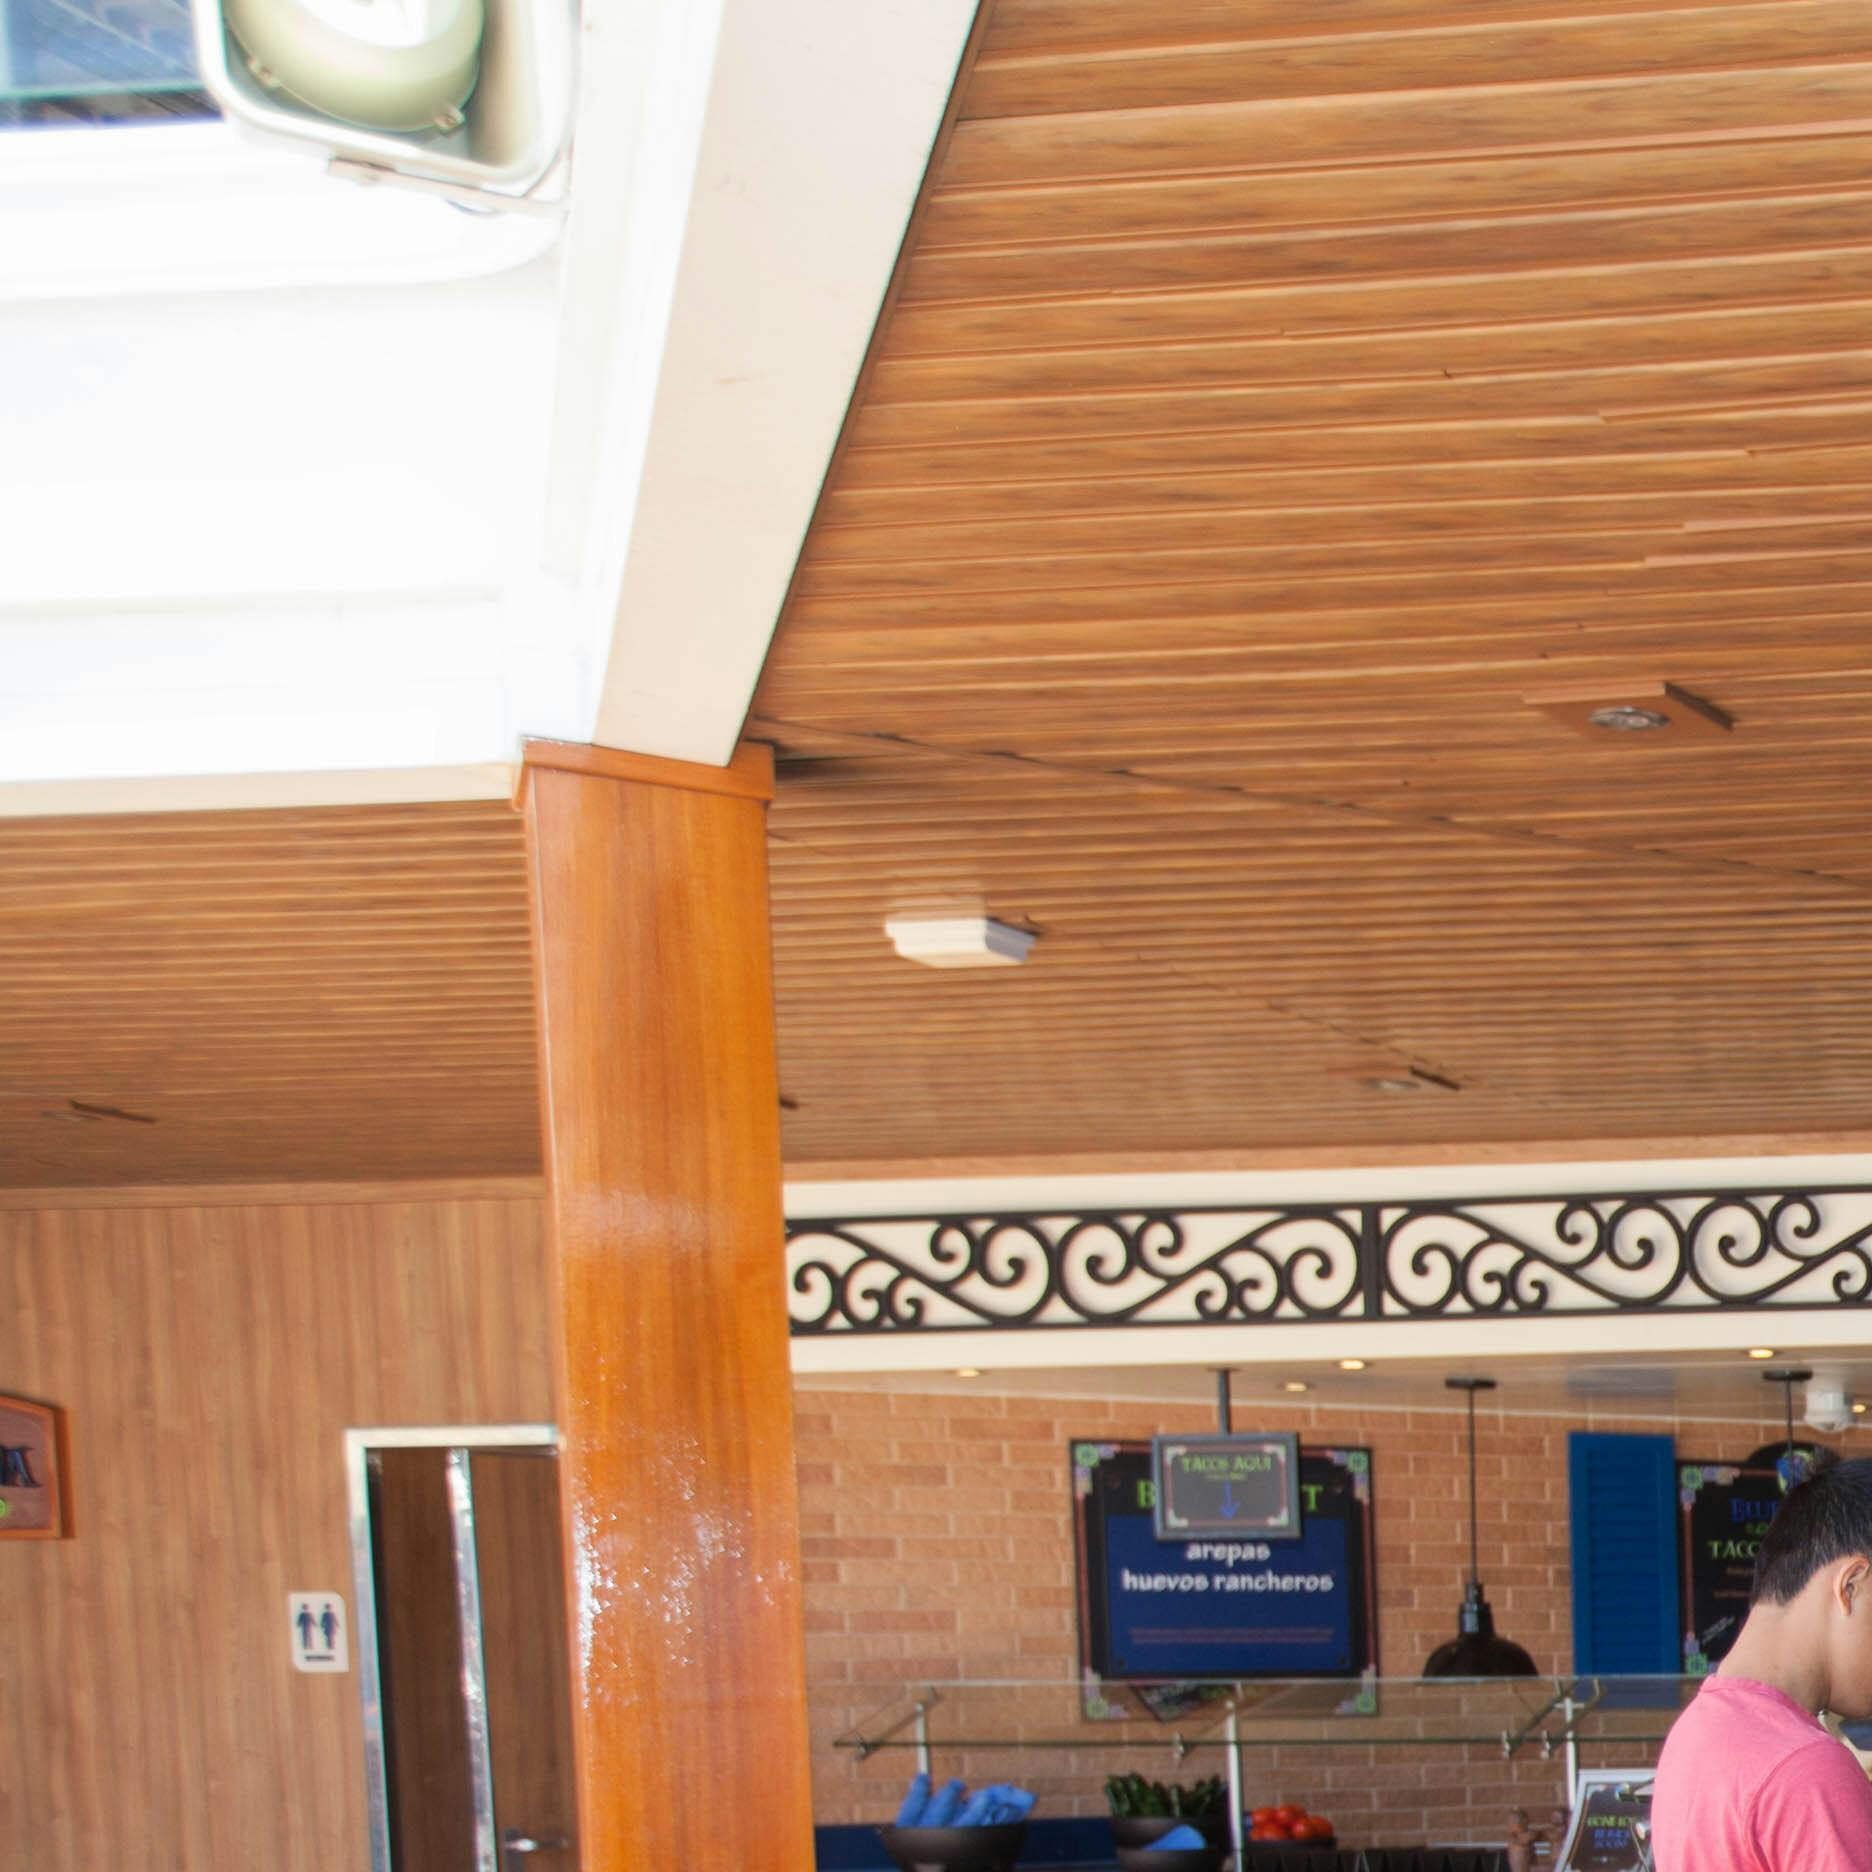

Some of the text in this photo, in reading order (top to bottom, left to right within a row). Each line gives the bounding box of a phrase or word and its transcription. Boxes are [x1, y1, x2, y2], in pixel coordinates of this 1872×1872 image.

[1186, 1543, 1271, 1566] arepas
[1121, 1569, 1334, 1592] huevos rancheros
